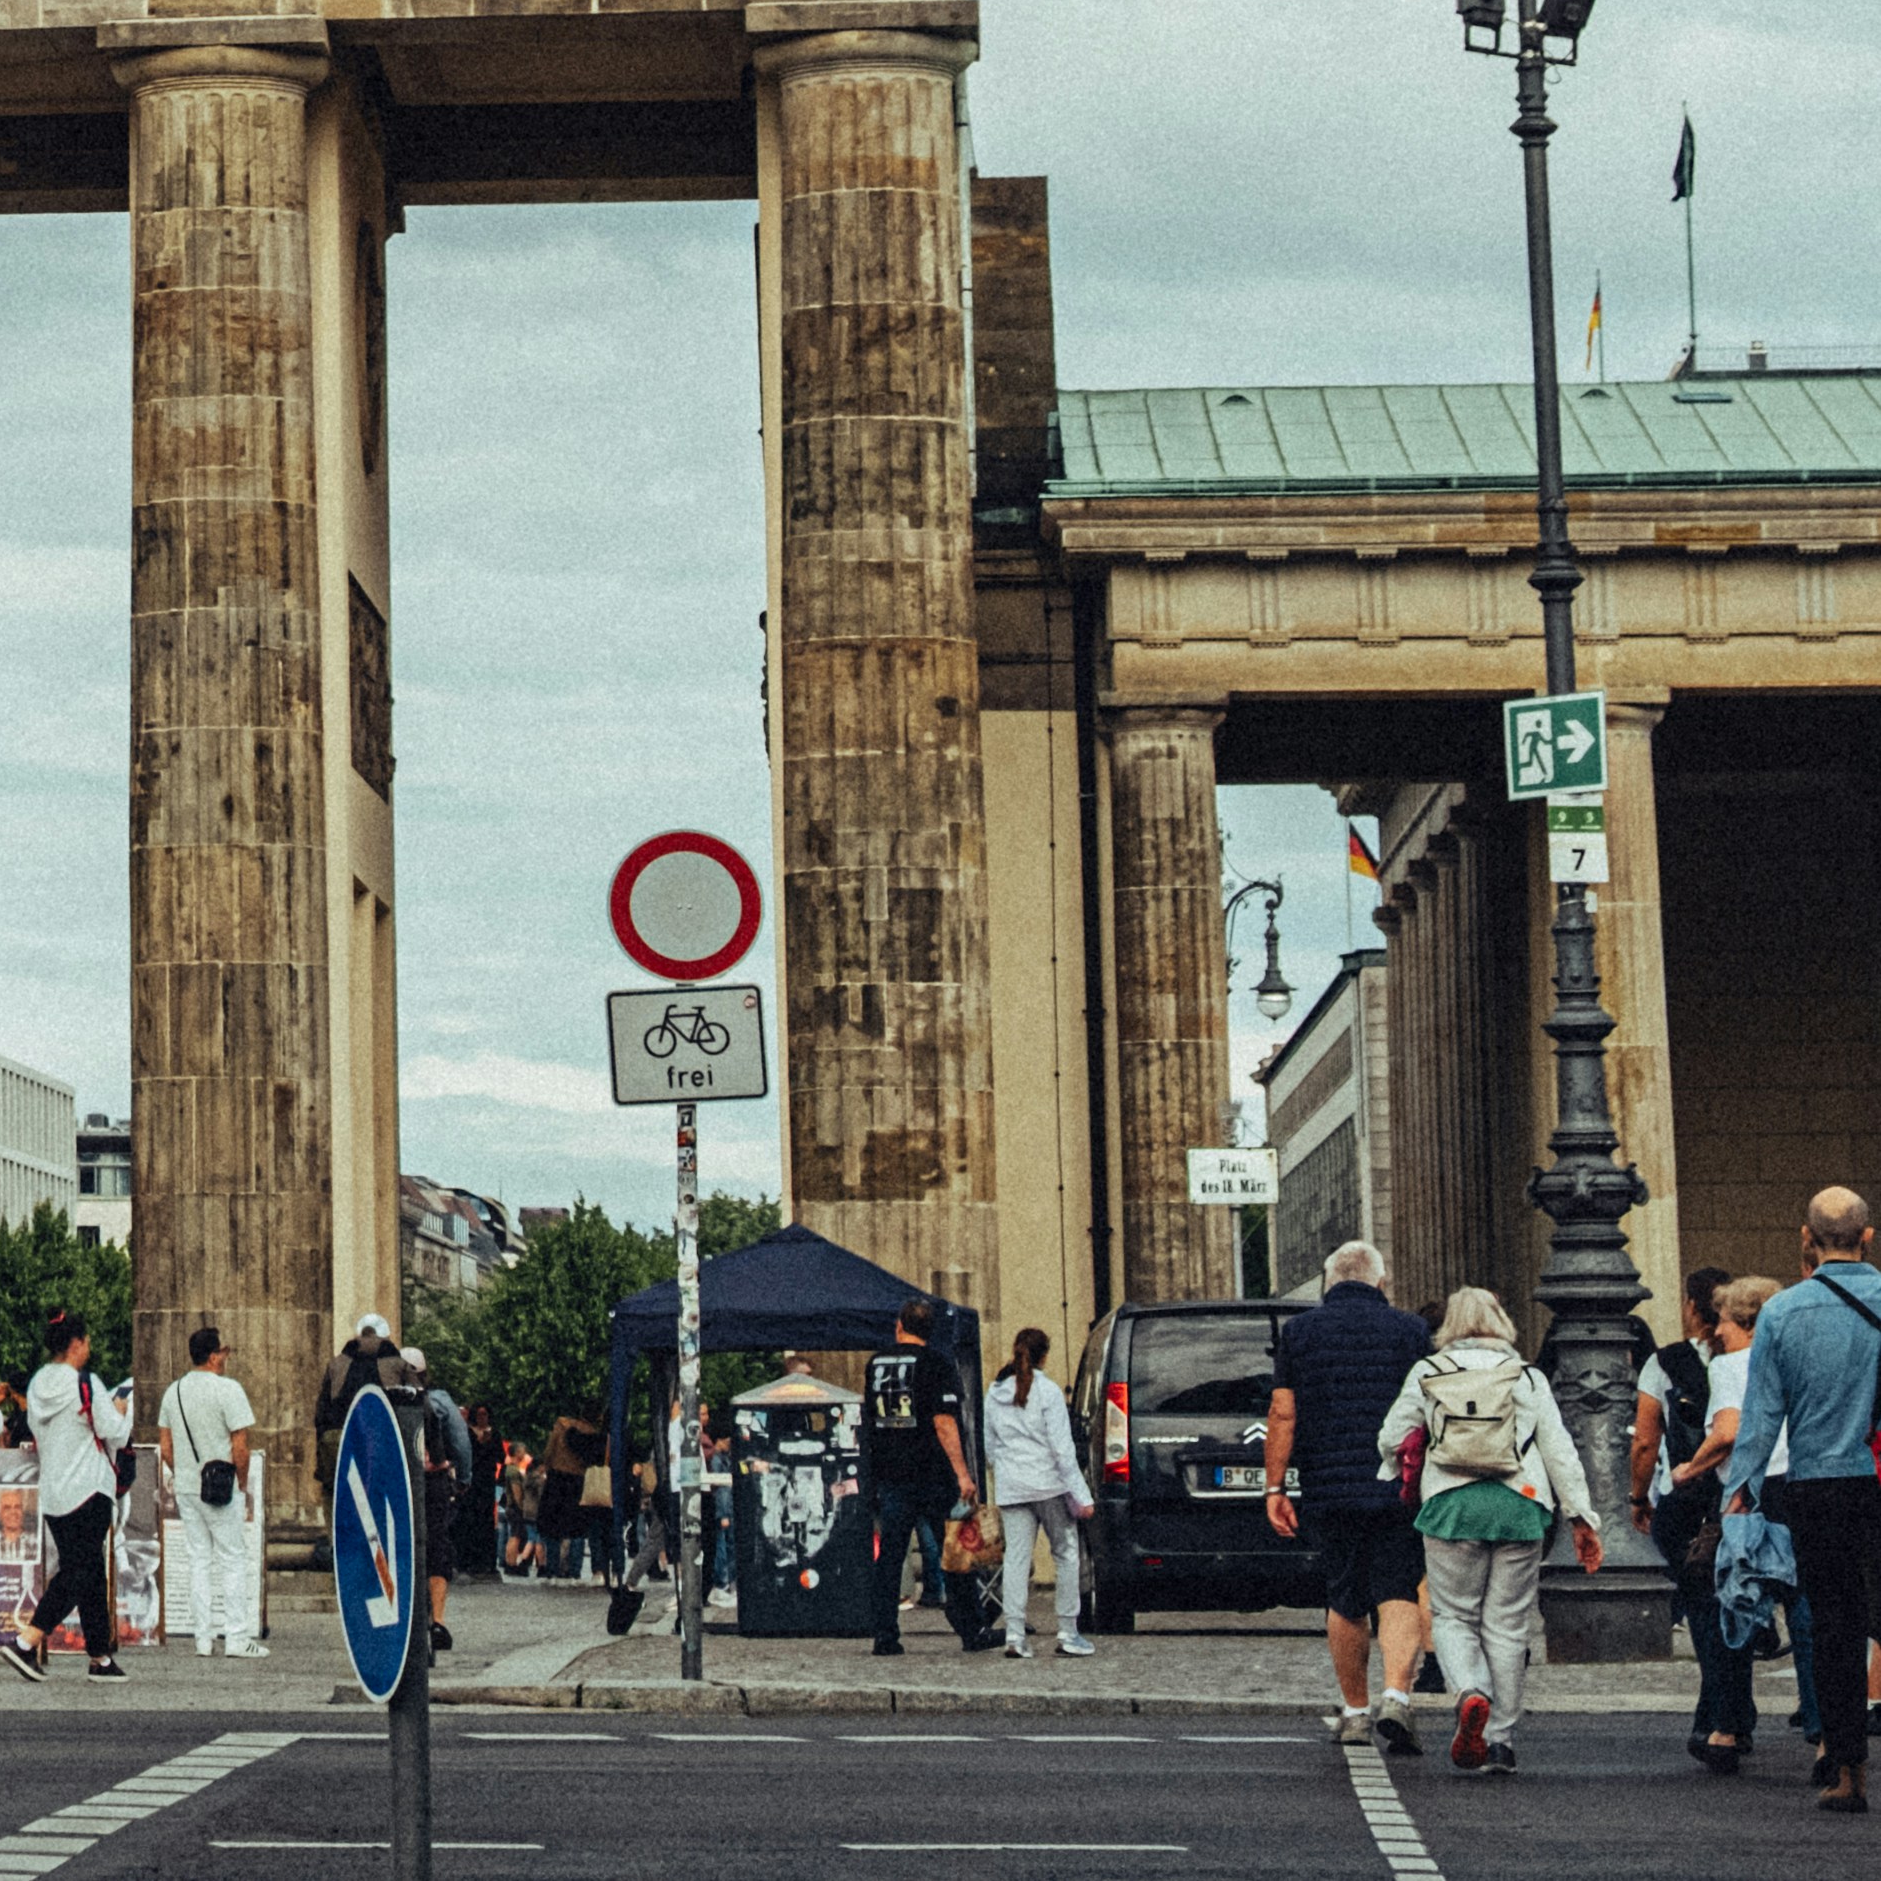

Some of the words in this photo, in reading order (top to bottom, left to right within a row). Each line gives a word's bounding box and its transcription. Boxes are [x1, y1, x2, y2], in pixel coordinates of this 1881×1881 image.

[1571, 848, 1586, 872] 7
[667, 1064, 714, 1089] frei
[1219, 1159, 1247, 1173] Platz
[1201, 1179, 1219, 1194] des
[1240, 1178, 1267, 1194] März
[1223, 1469, 1234, 1484] B
[1243, 1469, 1264, 1485] QE
